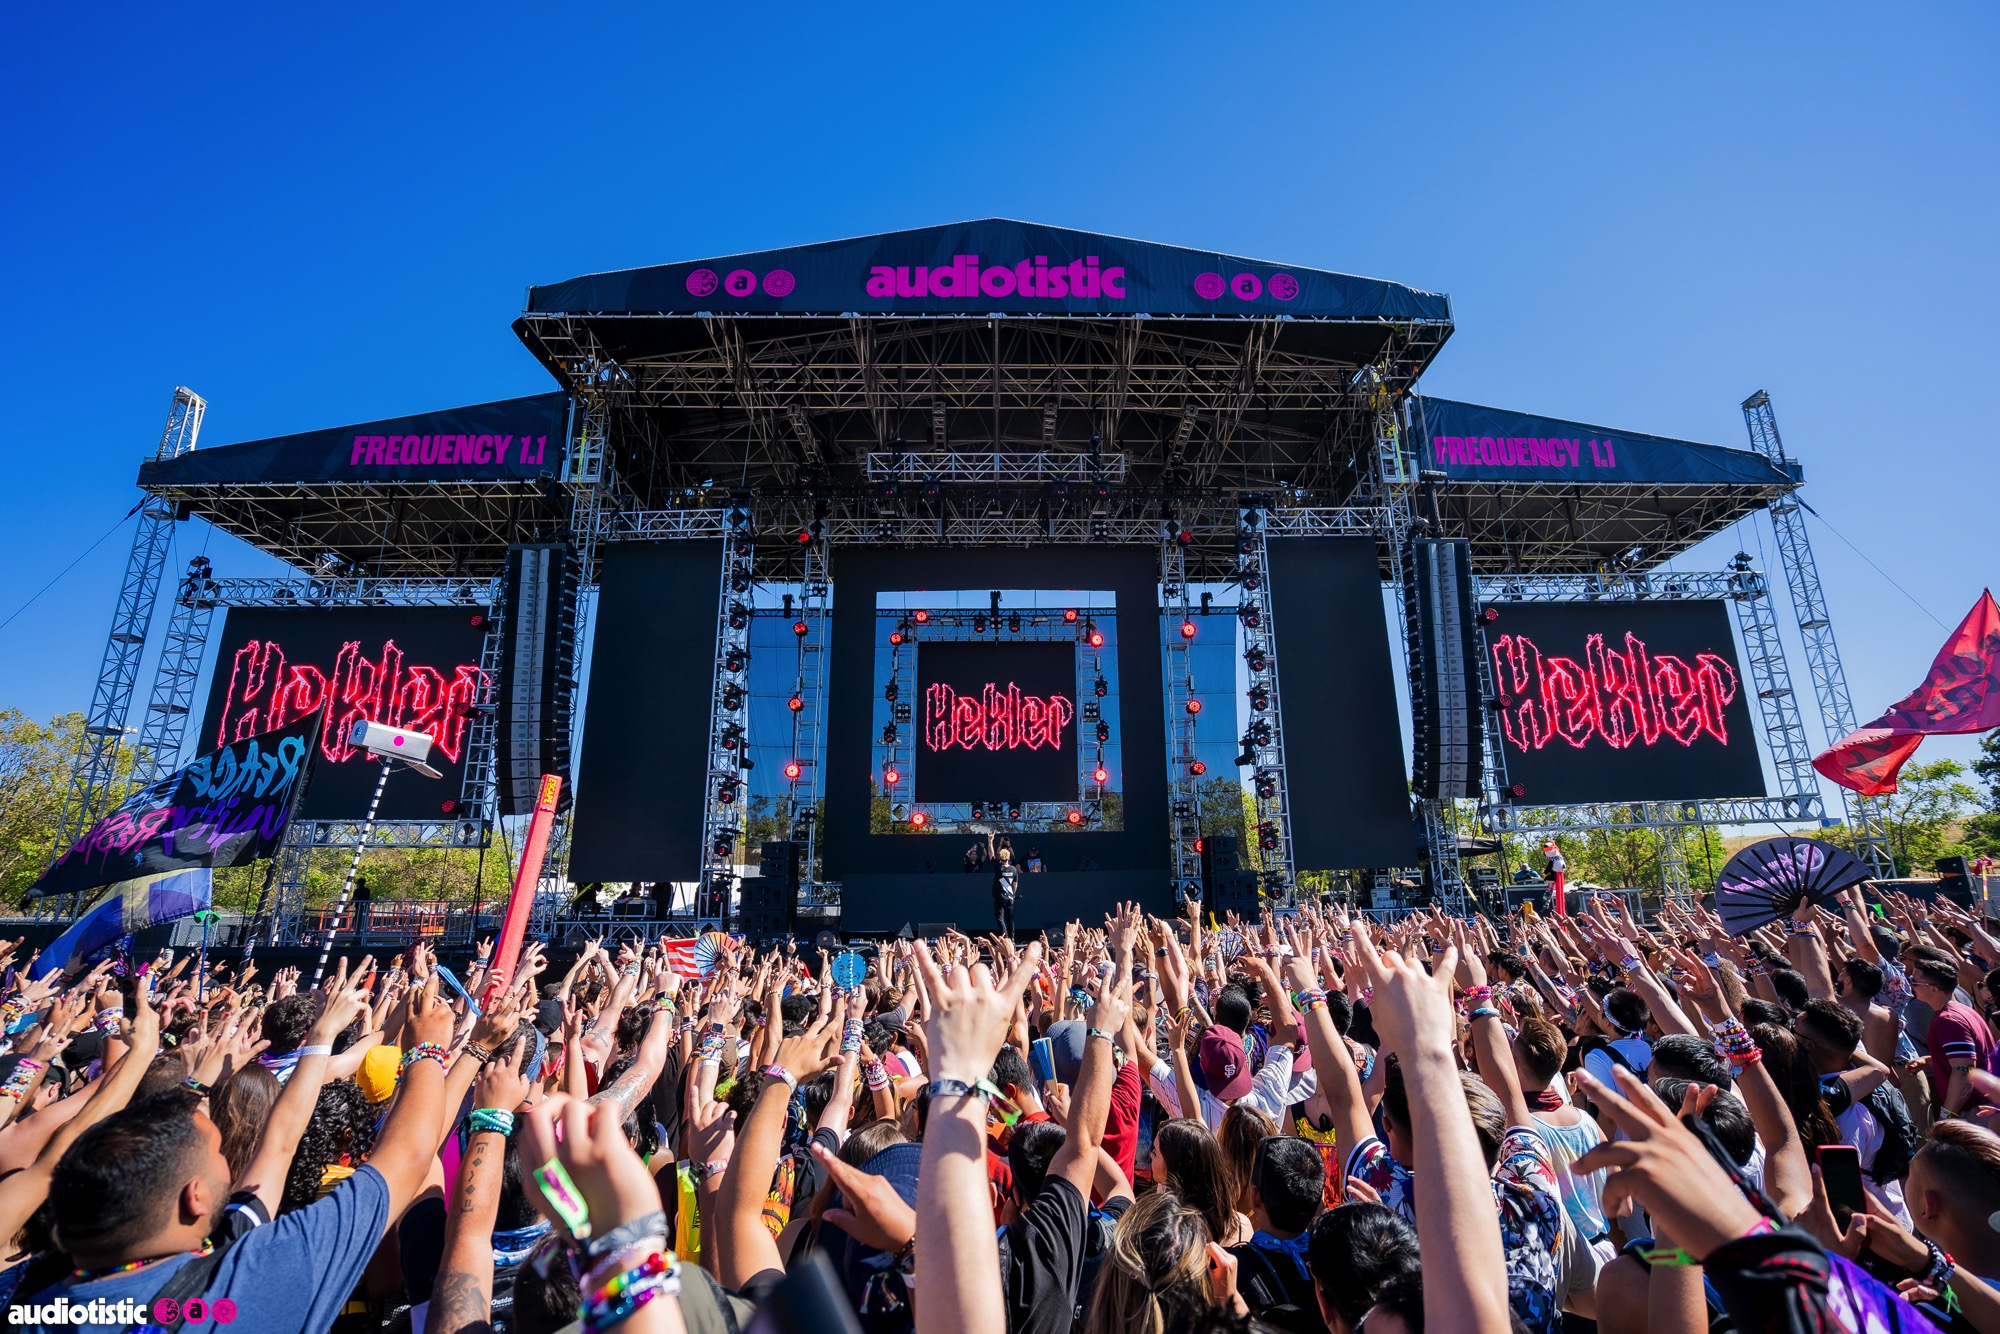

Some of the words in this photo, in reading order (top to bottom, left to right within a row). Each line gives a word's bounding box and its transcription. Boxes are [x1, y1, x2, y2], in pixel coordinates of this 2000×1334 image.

[866, 255, 1125, 298] audiotistic
[350, 435, 513, 465] FREQUENCY
[520, 435, 547, 464] 1.1
[1433, 436, 1580, 467] FREQUENCY
[1588, 439, 1616, 468] 1.1
[491, 1296, 513, 1306] Outdo
